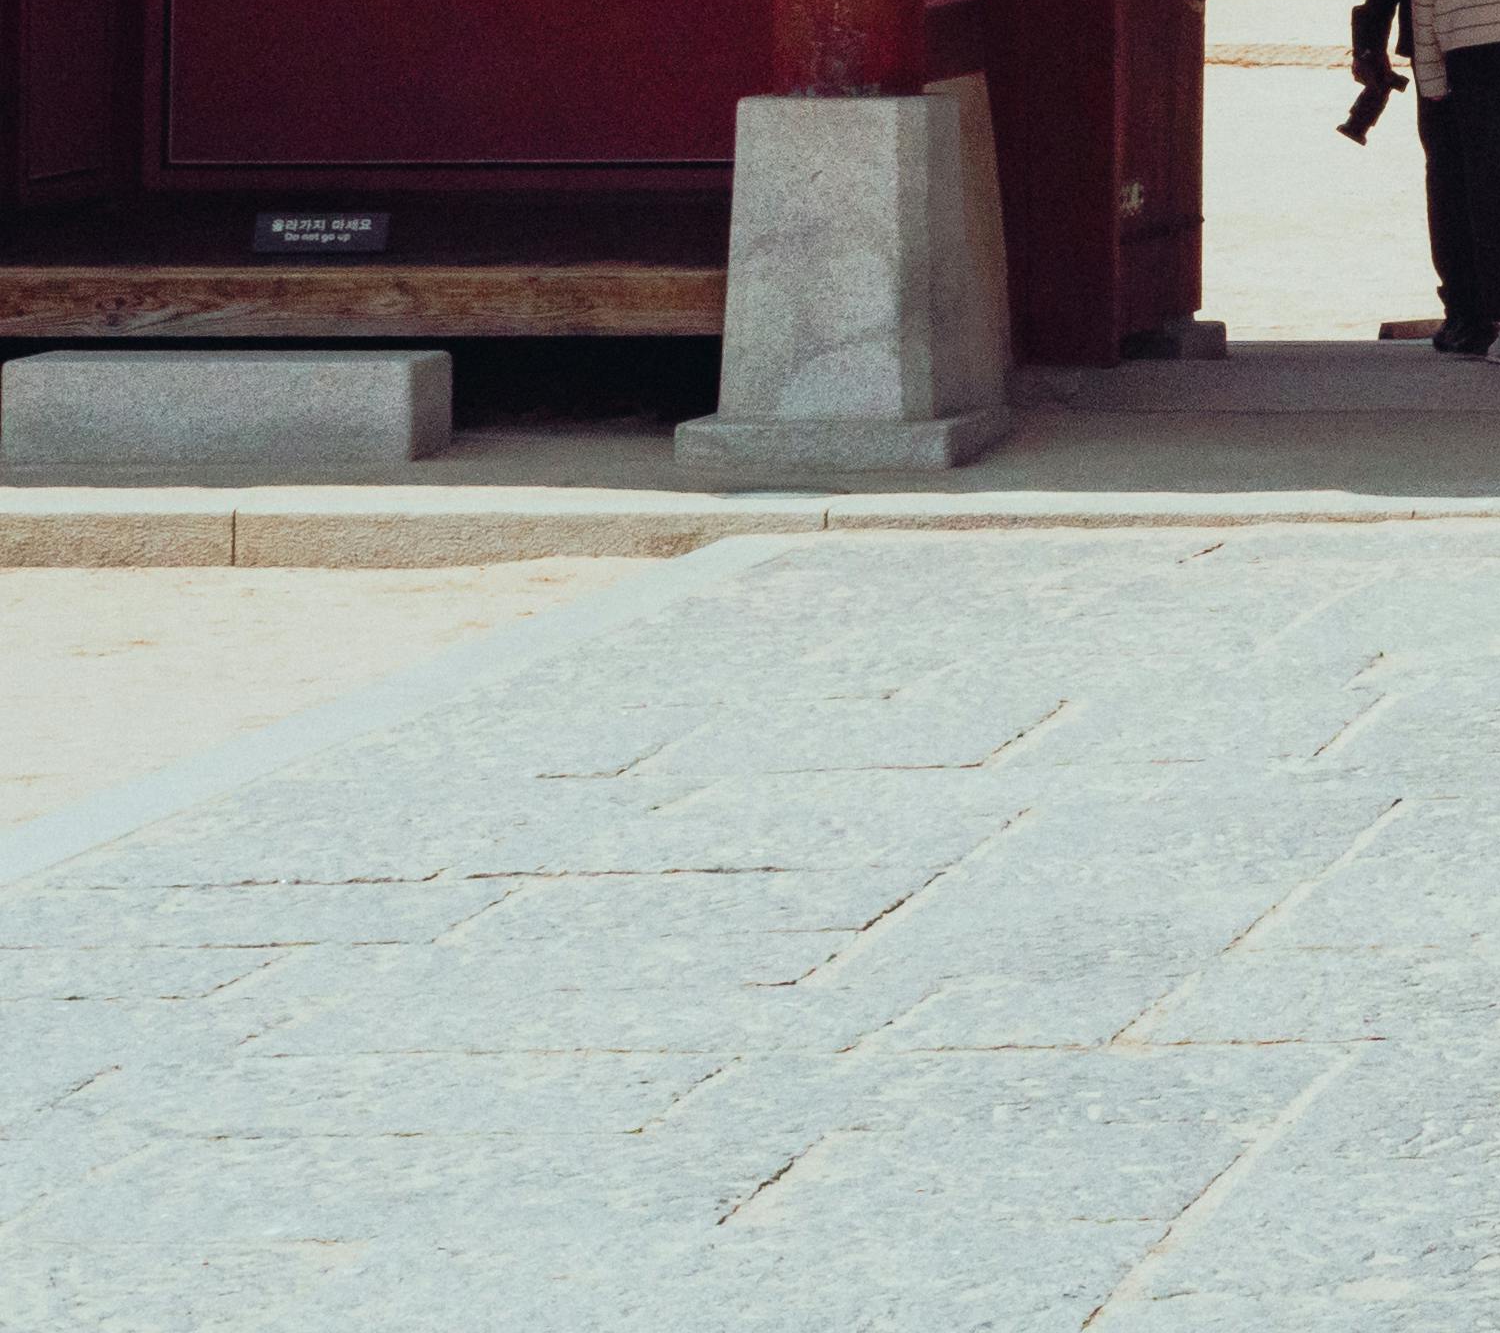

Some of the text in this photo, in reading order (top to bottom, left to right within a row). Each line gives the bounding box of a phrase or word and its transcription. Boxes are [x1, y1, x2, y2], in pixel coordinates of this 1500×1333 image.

[271, 219, 372, 232] 올라가지 마세요
[284, 233, 351, 243] Do not go up
